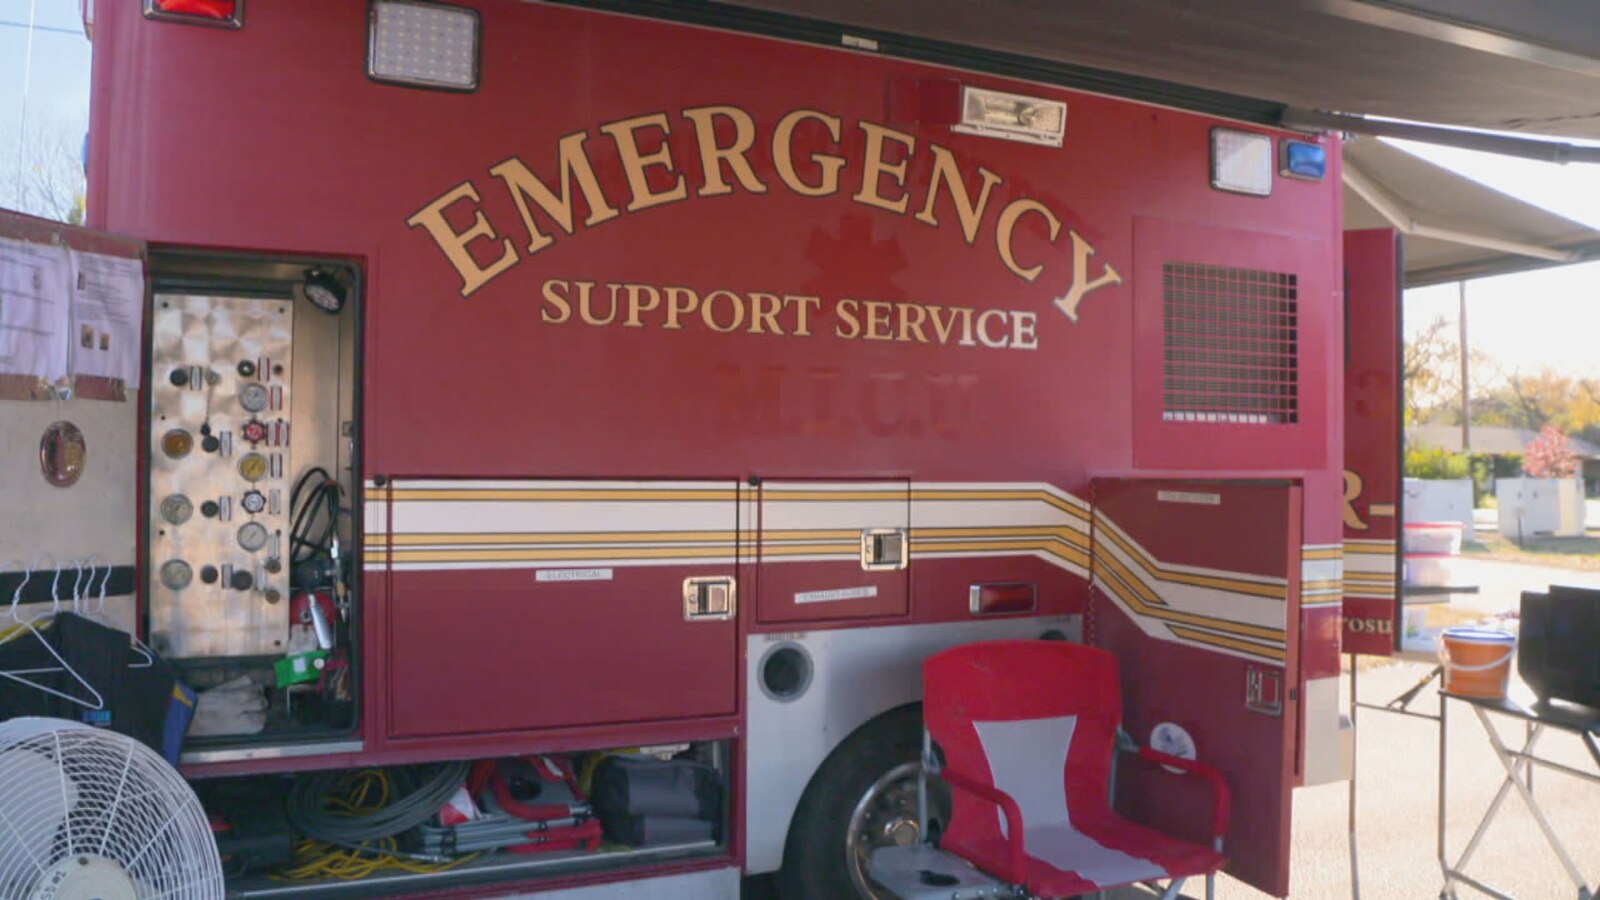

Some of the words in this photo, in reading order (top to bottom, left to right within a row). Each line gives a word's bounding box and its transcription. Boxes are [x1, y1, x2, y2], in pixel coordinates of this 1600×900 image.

[407, 104, 1123, 323] EMERGENCY
[540, 278, 821, 337] SUPPORT
[834, 298, 1039, 350] SERVICE
